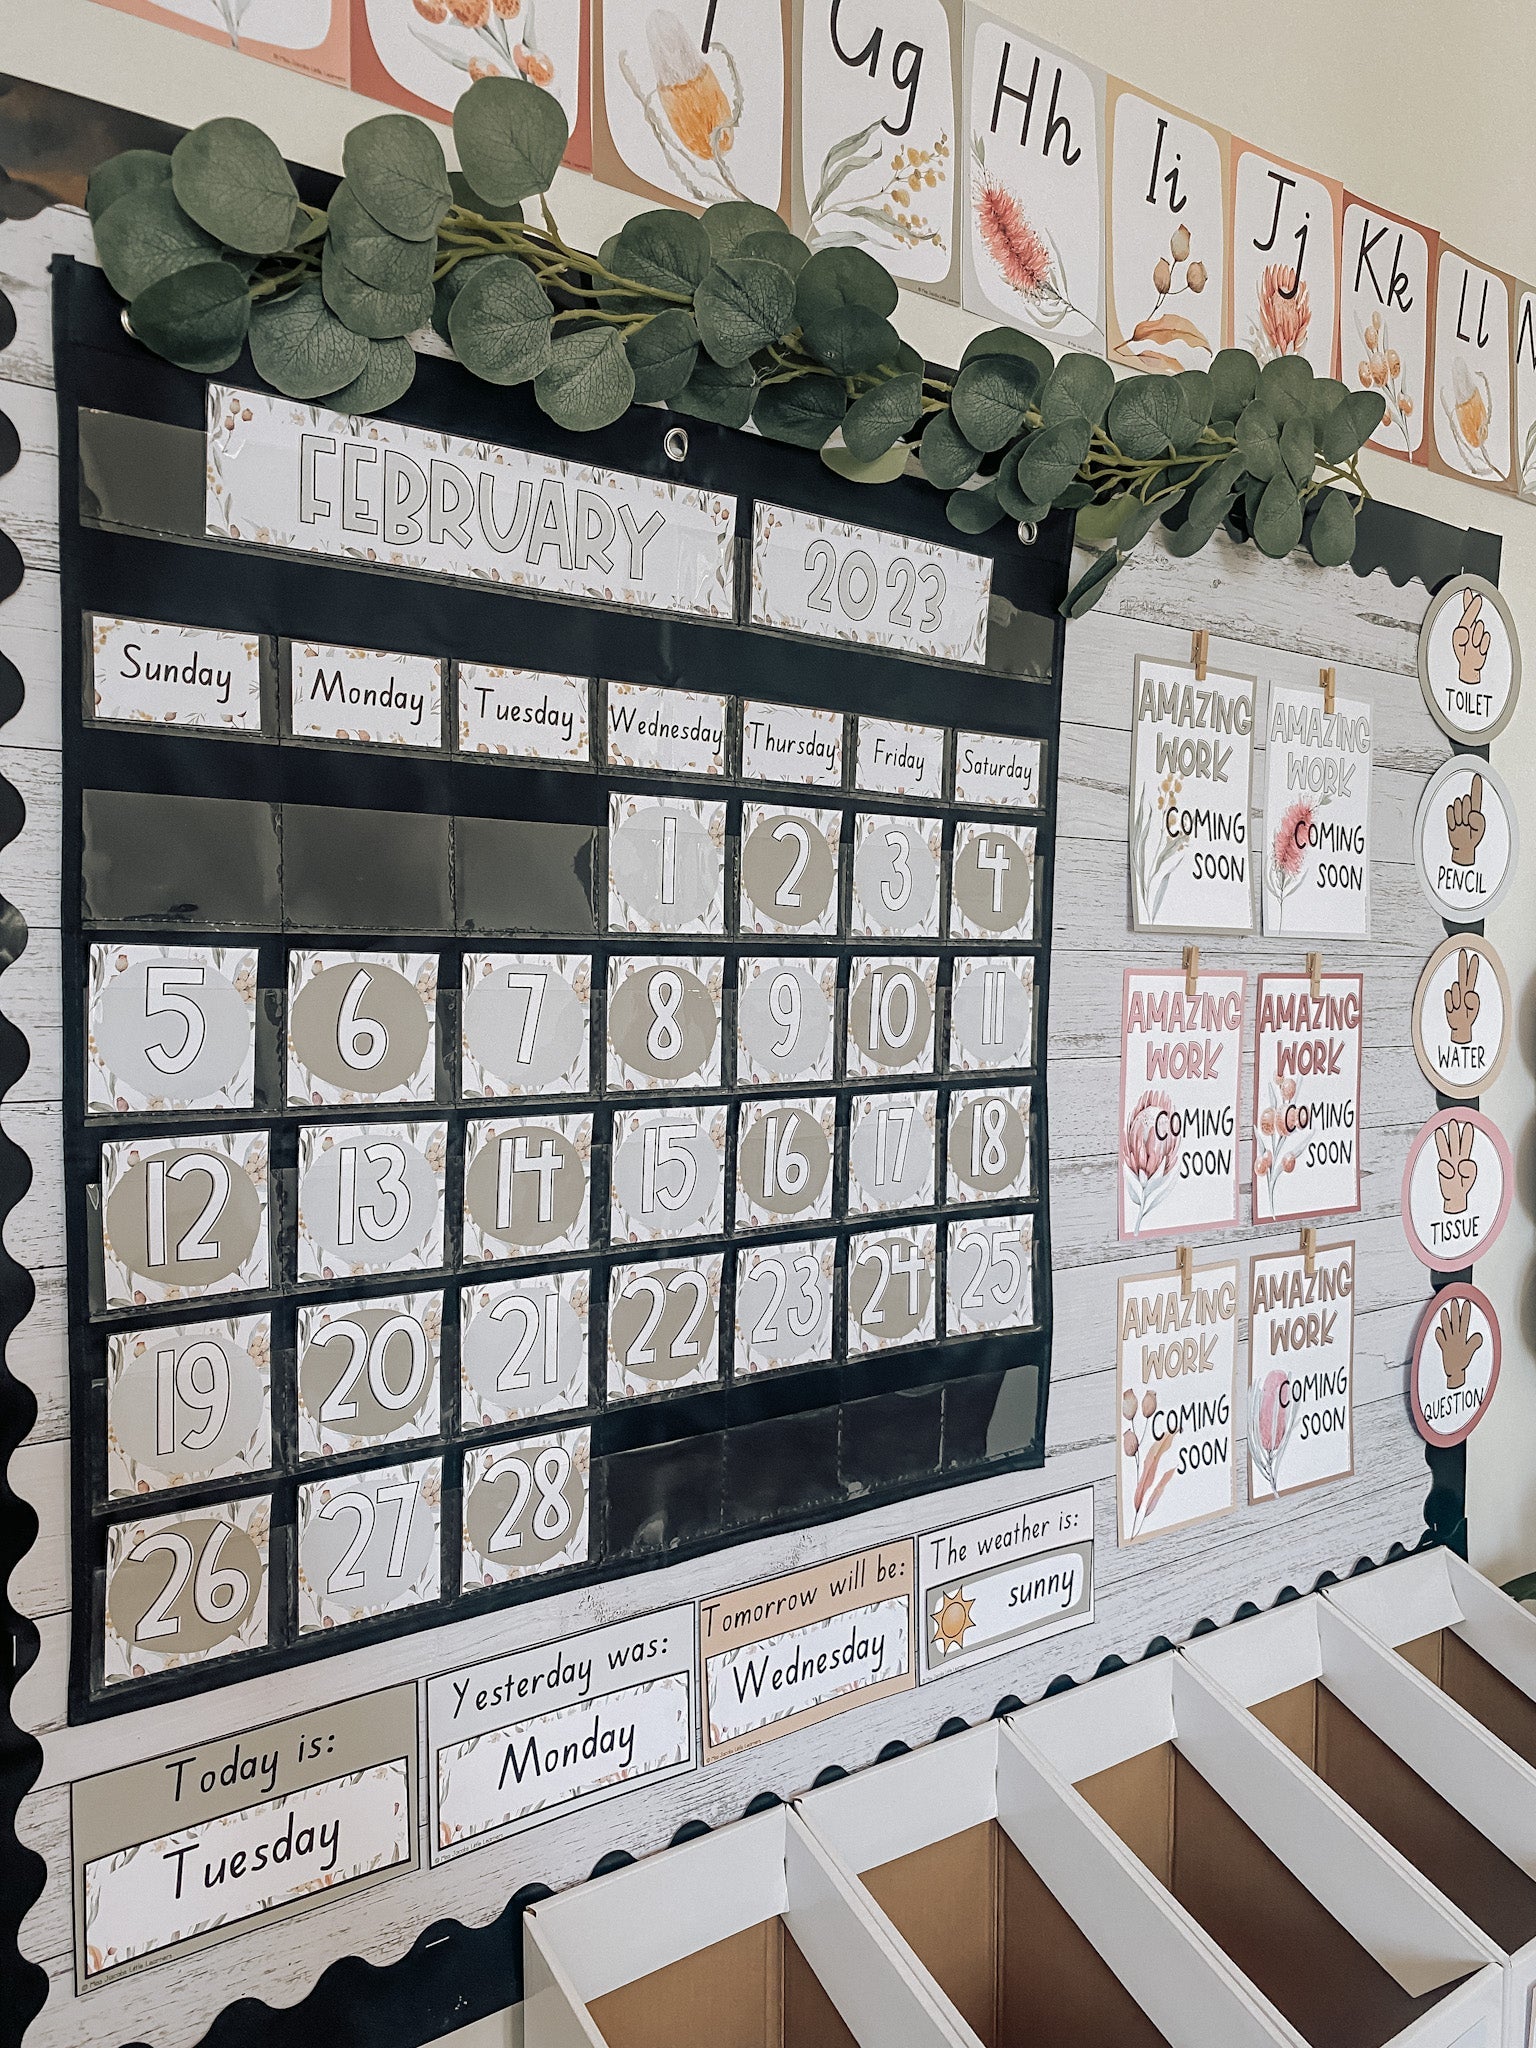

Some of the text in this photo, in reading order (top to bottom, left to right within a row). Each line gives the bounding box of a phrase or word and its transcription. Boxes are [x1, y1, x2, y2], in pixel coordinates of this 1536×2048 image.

[989, 41, 1082, 167] Hh
[1145, 117, 1187, 214] Ii
[1253, 171, 1311, 300] Jj
[1353, 218, 1414, 314] Kk
[1456, 269, 1490, 348] Ll
[300, 432, 667, 581] FEBRUARY
[803, 539, 947, 633] 2023
[120, 644, 232, 704] Sunday
[310, 669, 424, 726] Monday
[1138, 678, 1253, 736] AMAZING
[1445, 687, 1494, 719] TOILET
[473, 687, 574, 742] Tuesday
[610, 704, 725, 755] Wednesday
[749, 722, 837, 771] Thursday
[1270, 702, 1371, 754] AMAZING
[873, 738, 925, 783] Friday
[962, 749, 1033, 791] Saturday
[1155, 731, 1234, 783] WORK
[1287, 751, 1356, 798] WORK
[662, 816, 676, 905] 1
[1166, 806, 1246, 844] COMING
[1294, 819, 1365, 855] COMING
[771, 821, 811, 907] 2
[880, 830, 913, 912] 3
[977, 838, 1010, 913] 4
[1192, 851, 1245, 883] SOON
[1316, 863, 1363, 891] SOON
[1437, 865, 1487, 895] PENCIL
[145, 966, 206, 1075] 5
[336, 968, 388, 1070] 6
[507, 972, 547, 1065] 7
[646, 970, 684, 1061] 8
[769, 972, 802, 1058] 9
[868, 972, 916, 1051] 10
[982, 972, 1006, 1045] 11
[1127, 990, 1242, 1034] AMAZING
[1259, 992, 1360, 1033] AMAZING
[1146, 1038, 1224, 1081] WORK
[1277, 1037, 1346, 1077] WORK
[1438, 1045, 1486, 1070] WATER
[875, 1106, 915, 1186] 17
[971, 1099, 1008, 1177] 18
[1155, 1105, 1234, 1141] COMING
[1285, 1099, 1354, 1133] COMING
[496, 1137, 564, 1230] 14
[641, 1124, 697, 1214] 15
[763, 1113, 810, 1199] 16
[1180, 1149, 1232, 1180] SOON
[1306, 1140, 1353, 1168] SOON
[147, 1152, 232, 1267] 12
[338, 1142, 411, 1246] 13
[1431, 1215, 1480, 1245] TISSUE
[748, 1254, 822, 1344] 23
[856, 1243, 926, 1325] 24
[956, 1230, 1022, 1309] 25
[1253, 1259, 1352, 1315] AMAZING
[489, 1293, 559, 1392] 21
[621, 1269, 709, 1366] 22
[1122, 1281, 1237, 1341] AMAZING
[1270, 1309, 1338, 1356] WORK
[311, 1314, 429, 1423] 20
[1141, 1333, 1219, 1384] WORK
[1278, 1366, 1348, 1409] COMING
[155, 1341, 232, 1456] 19
[1151, 1393, 1230, 1442] COMING
[1300, 1406, 1346, 1440] SOON
[1423, 1386, 1485, 1424] QUESTION
[1177, 1437, 1228, 1475] SOON
[482, 1446, 572, 1554] 28
[318, 1481, 420, 1595] 27
[930, 1511, 1080, 1570] The weather is:
[127, 1521, 251, 1642] 26
[702, 1558, 906, 1638] Tomorrow will be:
[1008, 1569, 1075, 1608] sunny
[452, 1637, 668, 1720] Yesterday was:
[733, 1626, 886, 1704] Wednesday
[165, 1732, 336, 1802] Today is:
[498, 1714, 636, 1791] Monday
[163, 1811, 341, 1900] Tuesday
